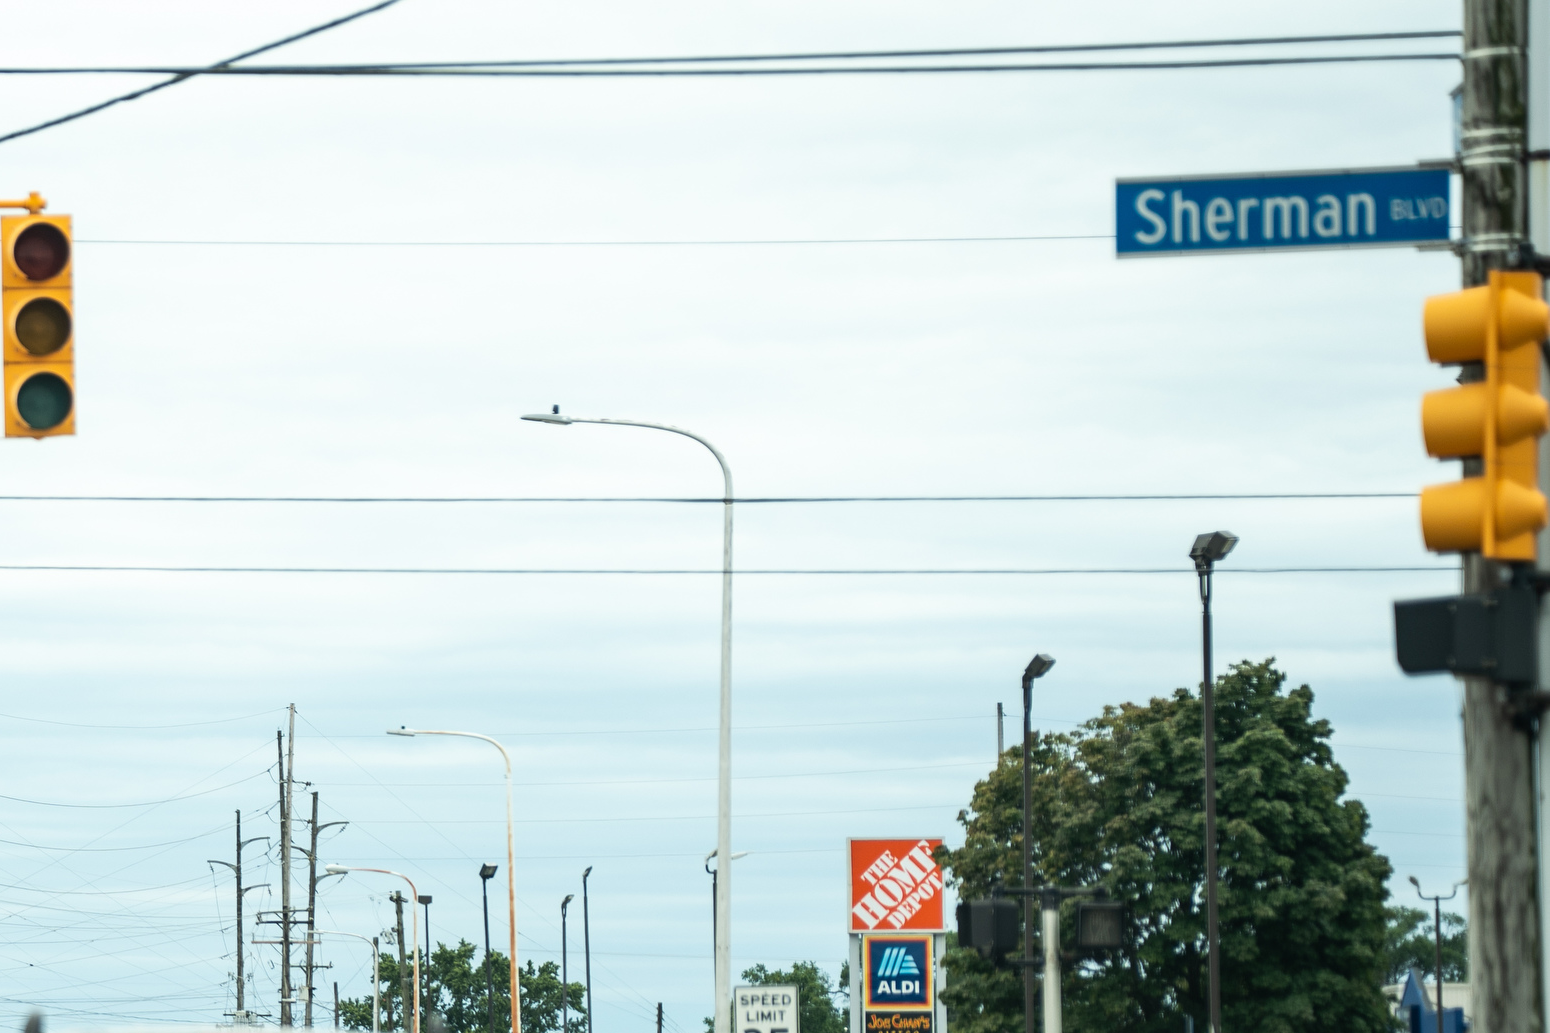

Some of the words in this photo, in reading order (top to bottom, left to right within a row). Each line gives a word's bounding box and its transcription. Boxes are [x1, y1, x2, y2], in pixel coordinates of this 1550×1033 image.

[1134, 188, 1377, 245] Sherman
[1389, 197, 1448, 221] BLVD
[852, 839, 936, 930] HOME
[861, 849, 898, 886] THE
[887, 872, 942, 930] DEPOT
[741, 994, 792, 1006] SPEED
[877, 980, 920, 994] ALDI
[746, 1010, 786, 1022] LIMIT
